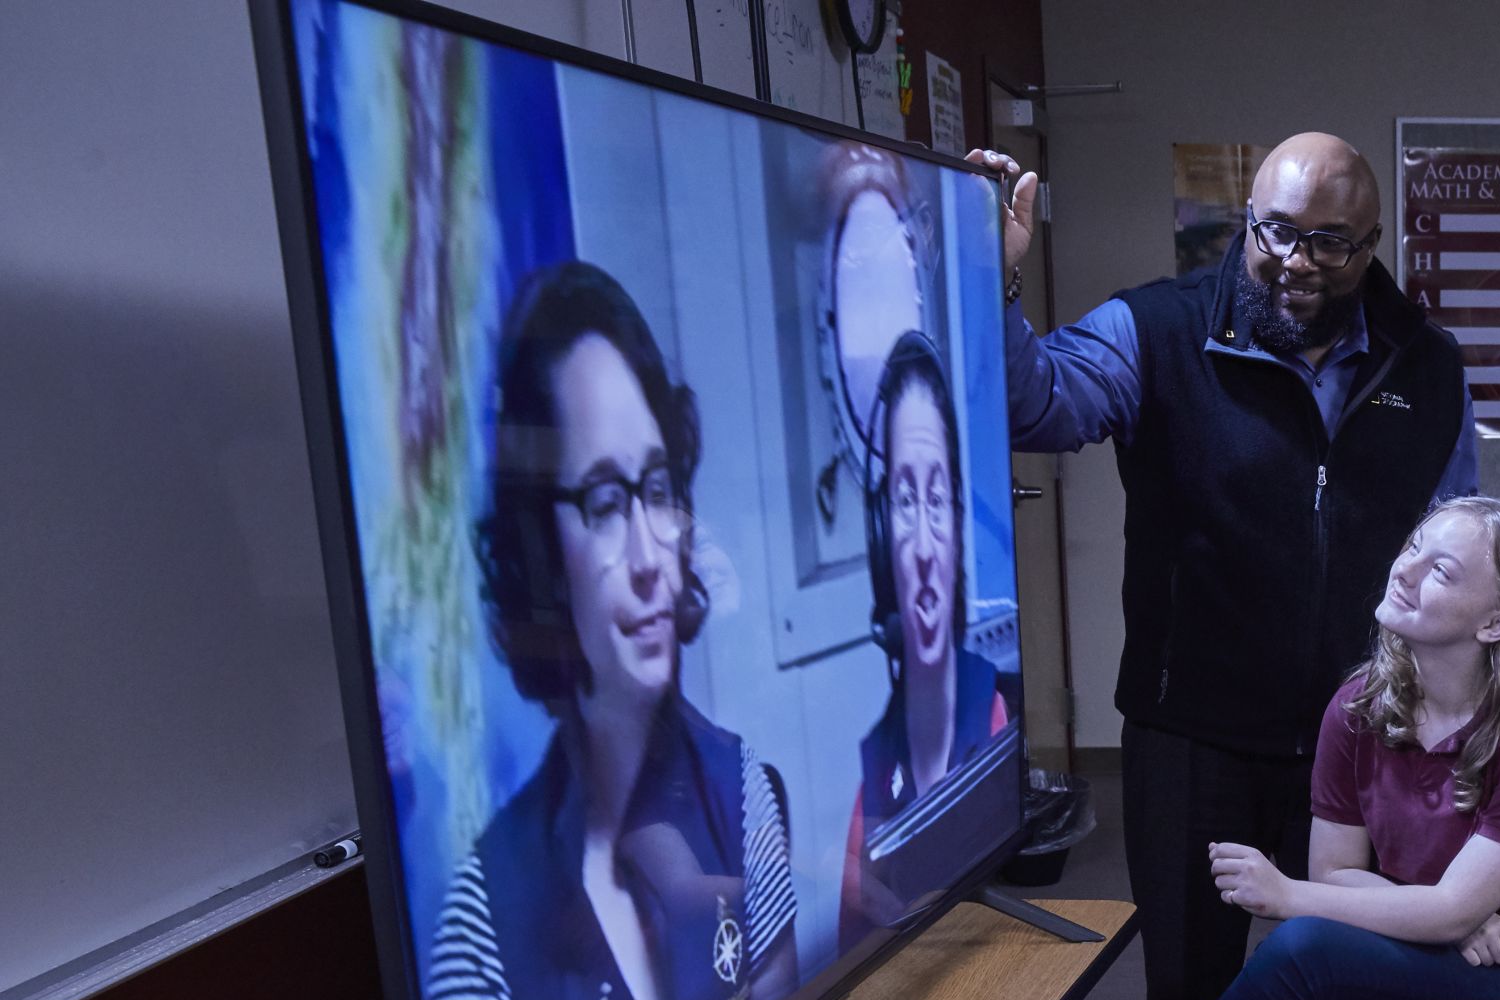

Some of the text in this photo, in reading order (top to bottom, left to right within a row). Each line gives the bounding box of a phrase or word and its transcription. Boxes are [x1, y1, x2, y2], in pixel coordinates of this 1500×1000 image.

[1410, 181, 1471, 200] MATH
[1478, 180, 1495, 200] &
[1415, 214, 1432, 233] C
[1414, 252, 1433, 271] H
[1416, 289, 1432, 309] A
